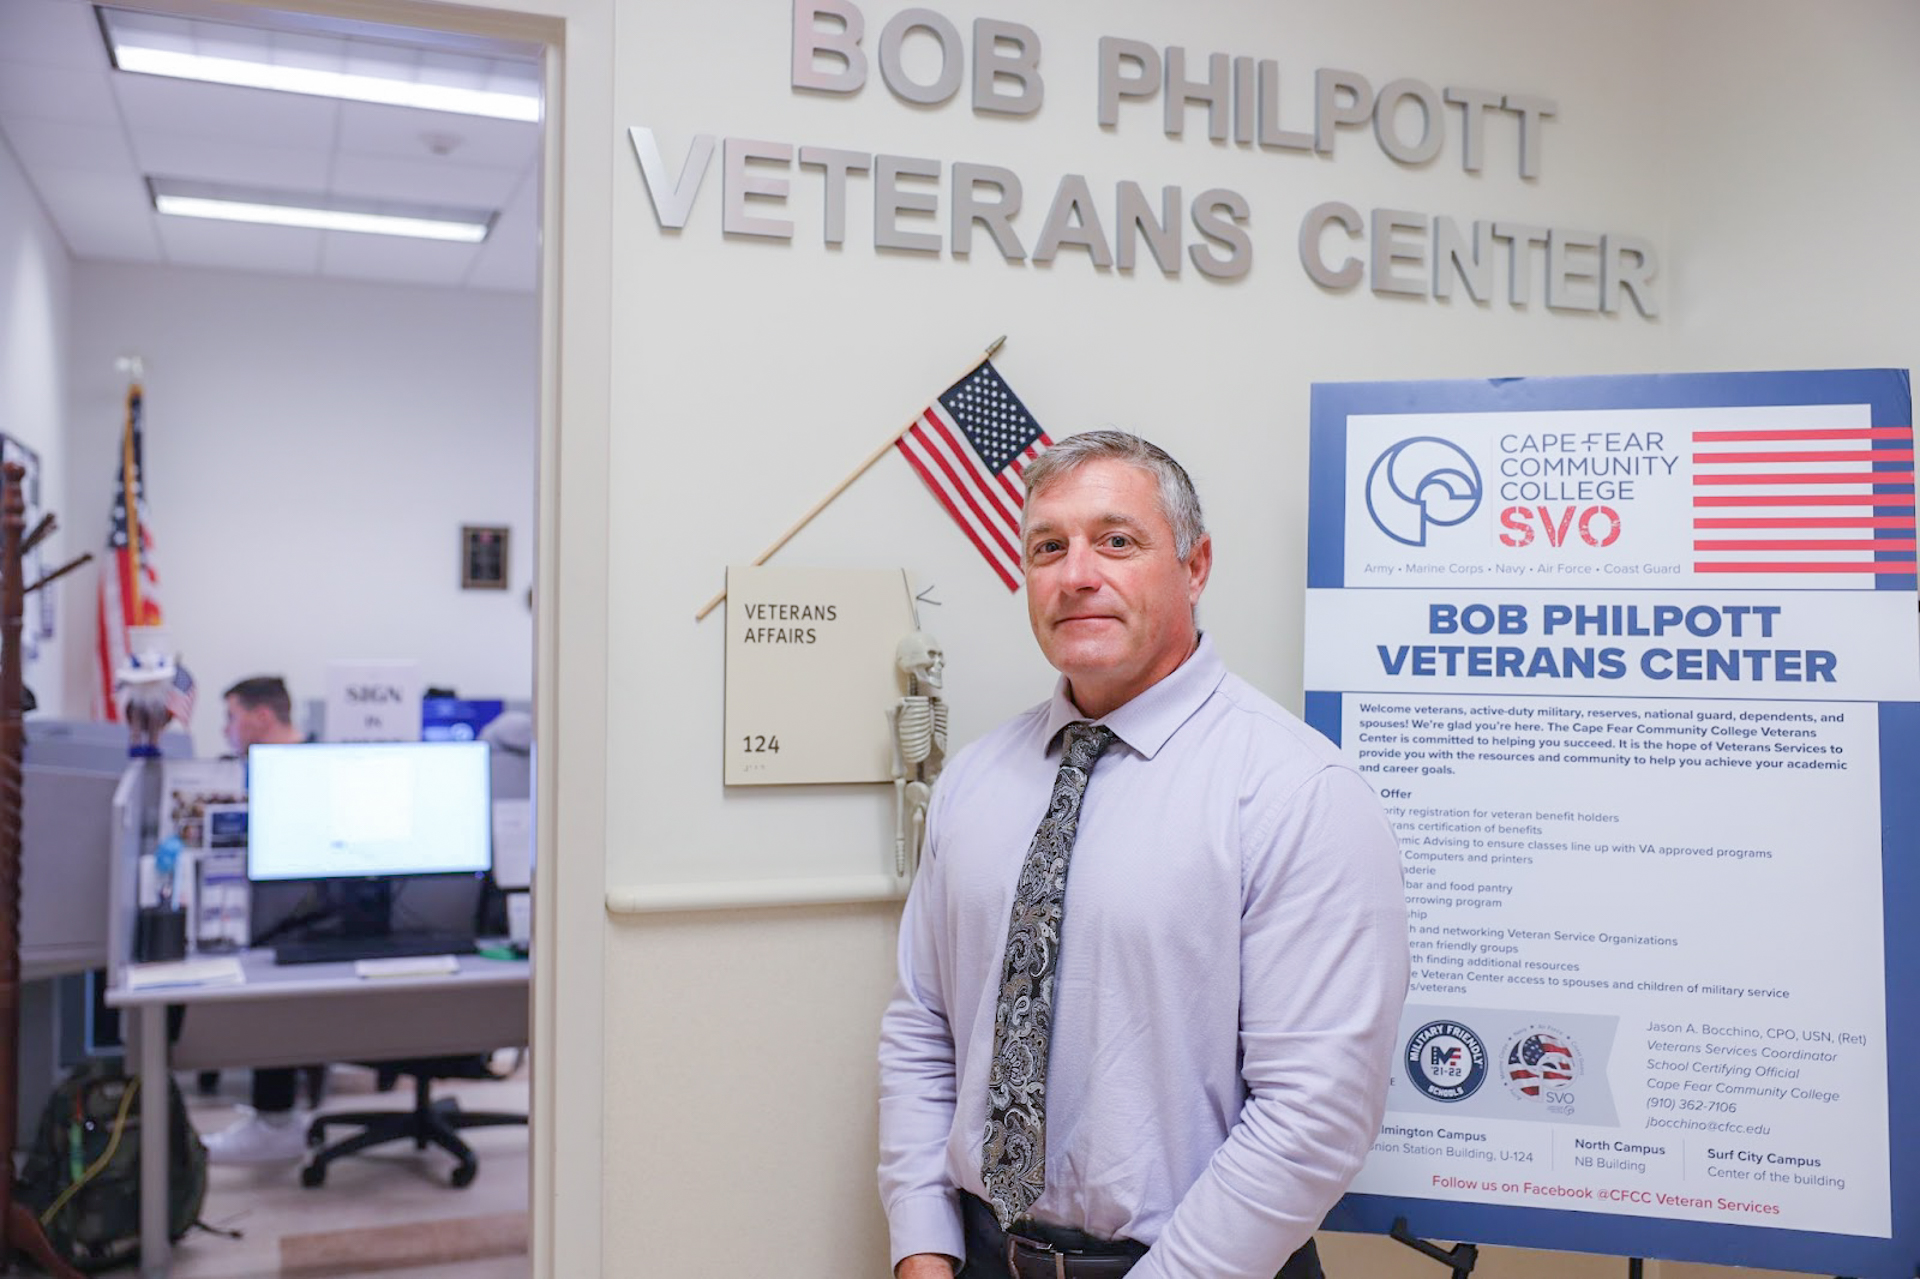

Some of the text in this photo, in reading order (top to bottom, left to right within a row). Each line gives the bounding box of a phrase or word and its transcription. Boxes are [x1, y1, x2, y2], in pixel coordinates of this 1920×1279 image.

[791, 0, 1557, 180] BOB PHILPOTT
[627, 125, 1660, 321] VETERANS CENTER
[1500, 432, 1664, 454] CAPE FEAR
[1500, 456, 1679, 477] COMMUNITY
[1500, 481, 1635, 501] COLLEGE
[1499, 505, 1621, 547] SVO
[1364, 563, 1680, 576] Army Marine Corps Navy Air Force Coast Guard
[744, 603, 837, 621] VETERANS
[1428, 602, 1782, 639] BOB PHILPOTT
[744, 628, 817, 644] AFFAIRS
[1376, 644, 1838, 682] VETERANS CENTER
[346, 684, 402, 702] SIGN
[1360, 703, 1844, 724] Welcome veterans, active-duty military, reserves, national guard, dependents, and
[1360, 719, 1817, 739] spouses! We're glad you're here. The Cape Fear Community College Veterans
[743, 735, 780, 754] 124
[1359, 733, 1827, 754] Center committed helping you succeed. hope Veterans Services
[1359, 748, 1847, 770] provide you with resources community help you achieve your academic
[1359, 763, 1455, 776] and career goals.
[1381, 788, 1412, 799] Offer
[1409, 806, 1619, 823] registration veteran benefit holders
[1418, 822, 1542, 835] certification benefits
[1405, 849, 1533, 865] Computers printers
[1423, 836, 1470, 849] Advising
[1487, 840, 1524, 849] ensure
[1527, 840, 1568, 852] classes
[1571, 841, 1591, 852] line
[1611, 843, 1635, 853] with
[1639, 843, 1655, 854] VA
[1659, 846, 1713, 857] approved
[1717, 848, 1772, 860] programs
[1406, 880, 1513, 895] bar food pantry
[1455, 898, 1502, 909] program
[1443, 927, 1678, 946] networking Veteran Service Organizations
[1436, 939, 1519, 956] friendly groups
[1426, 954, 1464, 968] finding
[1467, 957, 1521, 969] additional
[1525, 961, 1580, 972] resources
[1421, 969, 1463, 981] Veteran
[1466, 971, 1504, 983] Center
[1507, 975, 1545, 985] access
[1562, 978, 1609, 989] spouses
[1637, 980, 1683, 993] children
[1702, 984, 1744, 998] military
[1748, 987, 1790, 999] service
[1646, 1021, 1866, 1047] Jason A. Bocchino, CPO, USN, (Ret)
[1409, 1024, 1444, 1062] MILITARY
[1446, 1025, 1484, 1066] FRIENDLY
[1647, 1039, 1838, 1062] Veterans Services Coordinator
[1647, 1058, 1800, 1079] School Certifying Official
[1428, 1085, 1464, 1097] SCHOOLS
[1546, 1091, 1575, 1105] SVO
[1647, 1077, 1840, 1104] Cape Fear Community College
[1646, 1097, 1737, 1113] (910) 362-7106
[1381, 1125, 1486, 1143] lmington Campus
[1645, 1116, 1770, 1135] jbocchino@cfcc.edu
[1403, 1142, 1534, 1163] Station Building, U-124
[1575, 1138, 1665, 1156] North Campus
[1575, 1156, 1645, 1175] NB Building
[1708, 1148, 1821, 1168] Surf City Campus
[1707, 1166, 1845, 1191] Center building
[1433, 1175, 1780, 1215] Follow us on Facebook @CFCC Veteran Services
